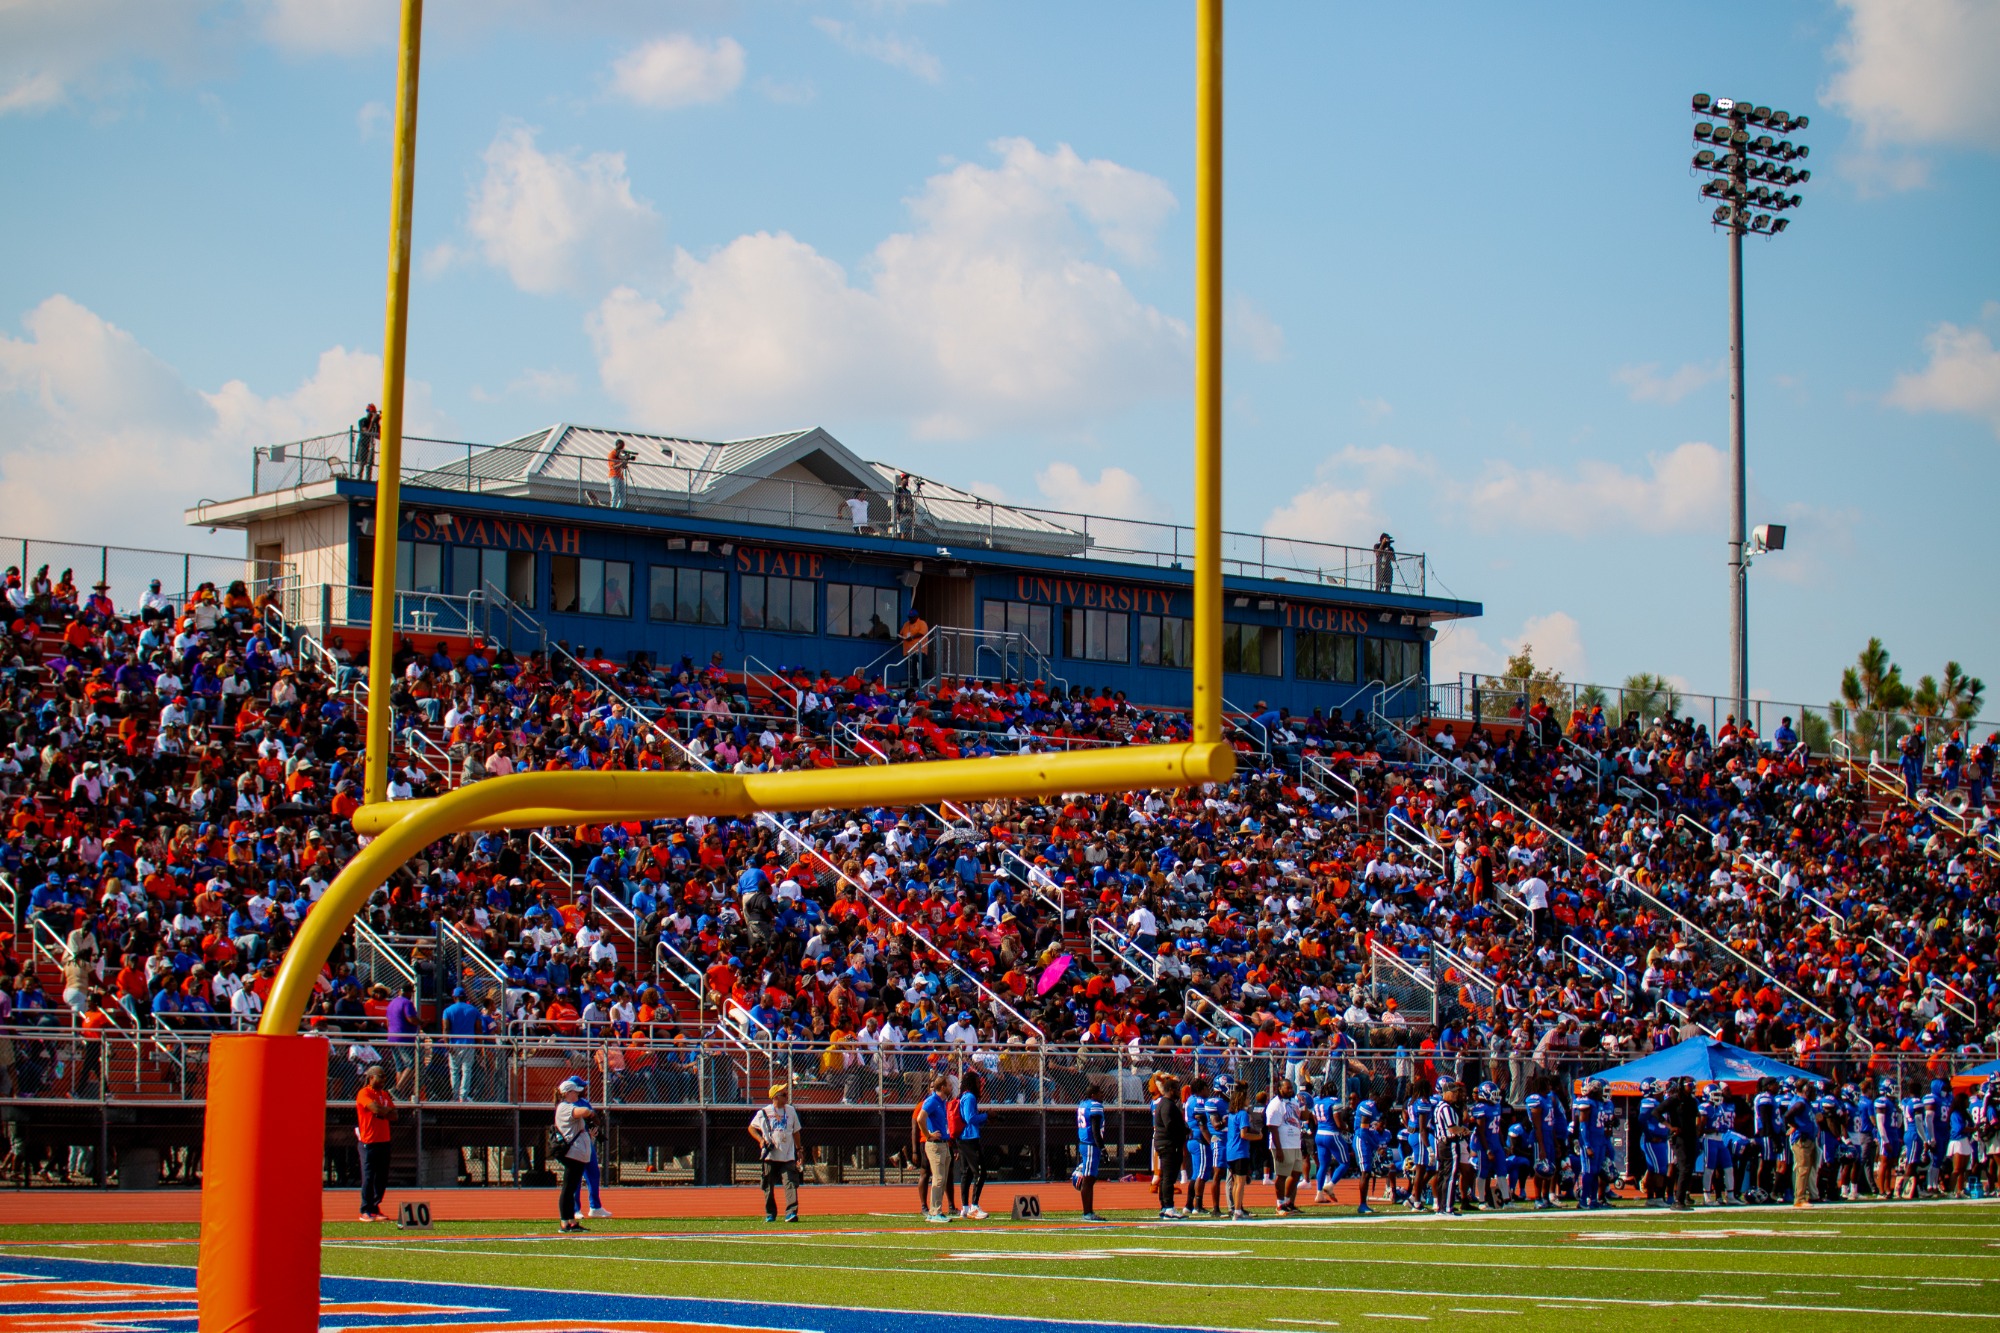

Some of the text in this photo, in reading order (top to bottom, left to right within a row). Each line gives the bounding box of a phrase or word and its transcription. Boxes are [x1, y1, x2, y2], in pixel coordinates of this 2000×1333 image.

[415, 513, 581, 555] SAVANNAH
[737, 546, 824, 579] STATE
[1018, 575, 1175, 615] UNIVERSITY
[1285, 604, 1368, 634] TIGERS
[404, 1203, 430, 1226] 10
[1019, 1196, 1040, 1217] 20
